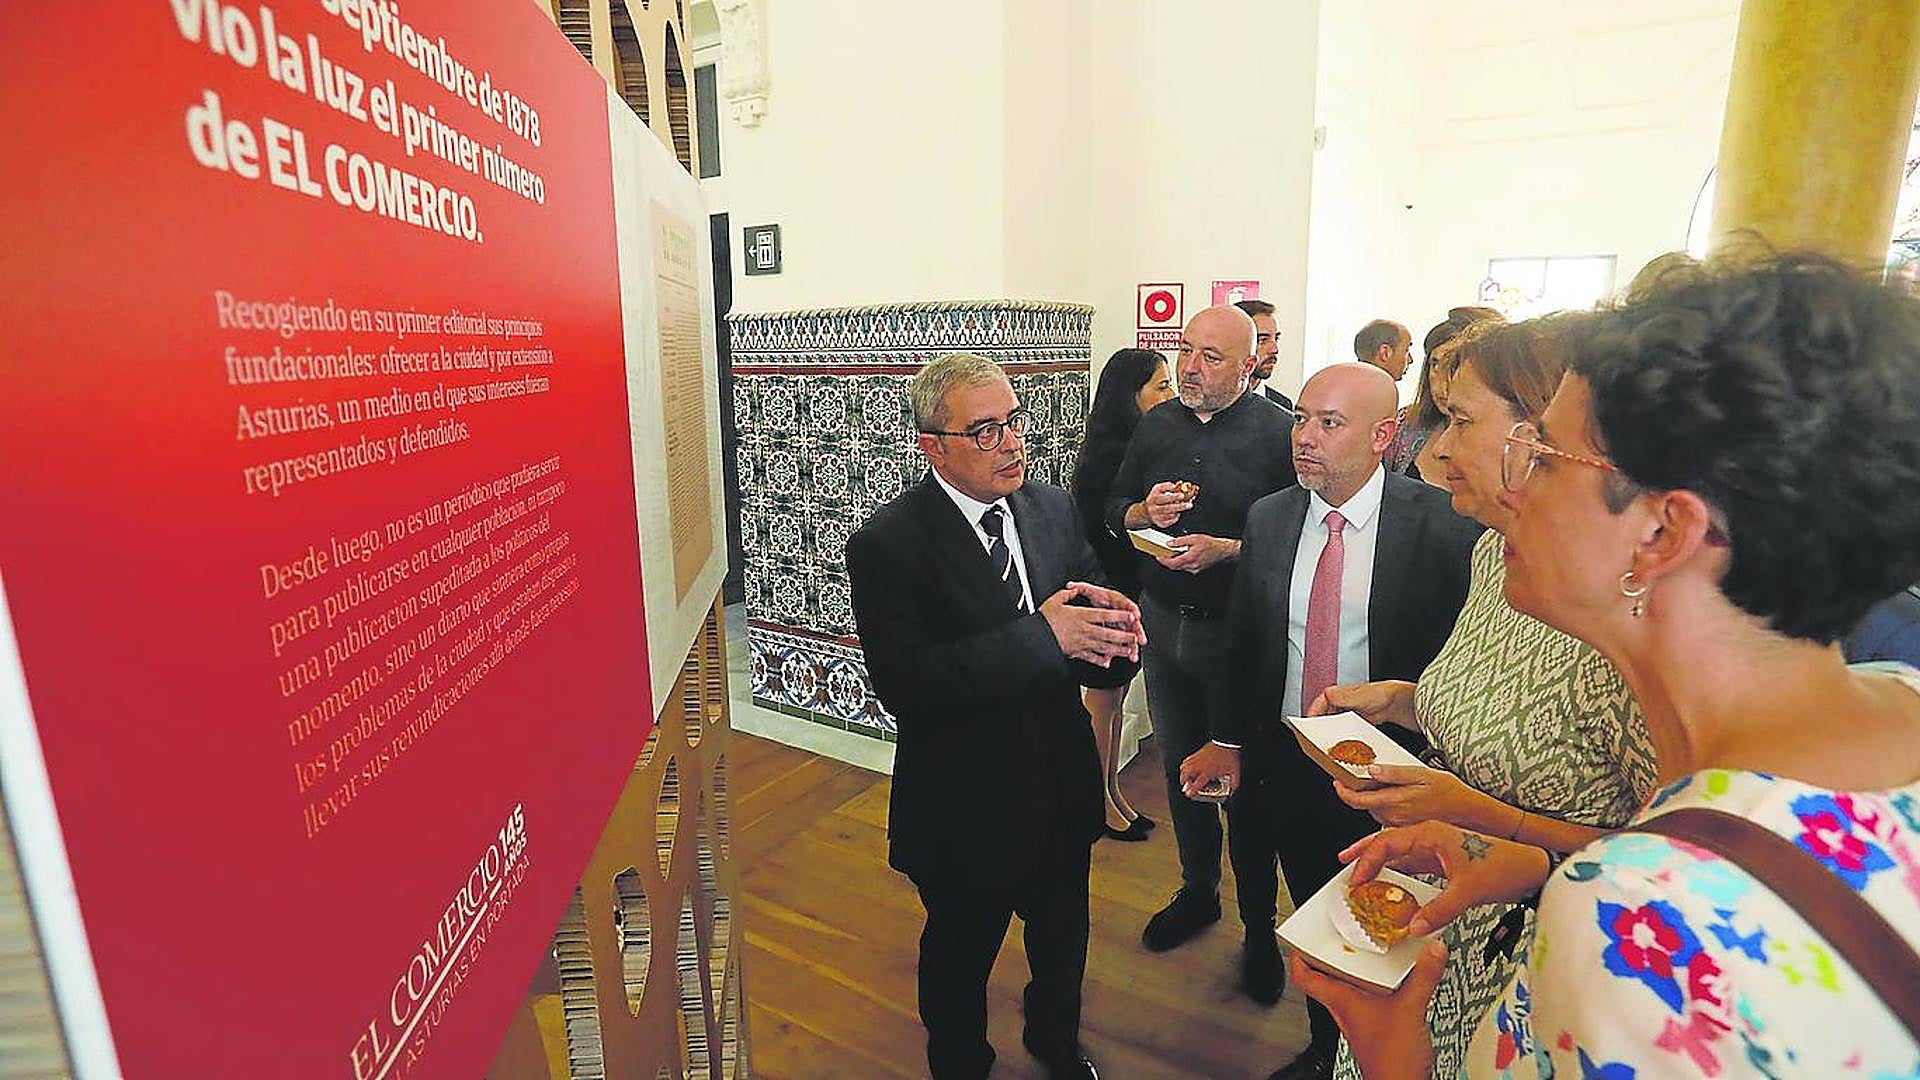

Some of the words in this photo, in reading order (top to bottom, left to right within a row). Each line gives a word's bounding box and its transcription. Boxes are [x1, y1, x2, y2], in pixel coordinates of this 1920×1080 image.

[185, 89, 260, 180] de
[262, 117, 323, 198] EL
[325, 143, 484, 243] COMERCIO.
[259, 4, 307, 96] la
[307, 33, 368, 124] luz
[370, 79, 400, 137] el
[401, 101, 481, 174] primer
[482, 144, 544, 204] número
[480, 70, 503, 124] de
[503, 90, 541, 148] 1878
[215, 290, 348, 338] Recogiendo
[351, 311, 372, 332] en
[375, 311, 395, 333] su
[396, 307, 442, 339] primer
[443, 308, 487, 336] editorial
[488, 318, 504, 336] sus
[504, 316, 543, 340] principios
[224, 346, 378, 385] fundacionales:
[380, 345, 430, 375] ofrecer
[431, 353, 440, 371] a
[440, 345, 453, 371] la
[453, 345, 488, 369] ciudad
[488, 351, 496, 373] y
[497, 351, 512, 373] por
[1138, 332, 1180, 341] PULSADOR
[236, 399, 335, 441] Asturias,
[337, 399, 362, 425] un
[364, 387, 412, 421] medio
[414, 391, 431, 411] en
[433, 382, 445, 408] el
[446, 386, 468, 411] que
[468, 383, 487, 403] sus
[487, 377, 525, 400] intereses
[244, 436, 387, 496] representados
[387, 436, 400, 464] y
[400, 418, 470, 456] defendidos.
[260, 546, 328, 600] Desde
[331, 530, 384, 568] luego,
[386, 519, 405, 545] no
[407, 511, 423, 534] es
[425, 503, 443, 527] un
[444, 482, 492, 524] periódico
[493, 476, 511, 500] que
[269, 603, 321, 657] para
[323, 561, 409, 628] publicarse
[411, 549, 430, 574] en
[430, 521, 482, 562] cualquier
[279, 656, 321, 698] una
[325, 594, 419, 677] publicación
[420, 554, 483, 609] supeditada
[483, 552, 490, 570] a
[490, 543, 504, 565] los
[287, 663, 384, 747] momento,
[386, 640, 417, 676] sino
[418, 624, 436, 652] un
[437, 599, 471, 637] diario
[471, 587, 490, 615] que
[294, 753, 327, 793] los
[330, 681, 416, 772] problemas
[417, 661, 434, 693] de
[435, 653, 449, 678] la
[449, 619, 485, 666] ciudad
[493, 606, 511, 632] que
[303, 775, 358, 839] llevar
[362, 748, 390, 785] sus
[391, 660, 489, 759] reivindicaciones
[503, 832, 526, 877] AÑOS
[351, 1019, 390, 1080] EL
[391, 845, 499, 1026] COMERCIO
[499, 803, 524, 856] 145
[407, 962, 470, 1072] ASTURIAS
[469, 930, 487, 963] EN
[486, 855, 530, 933] PORTADA
